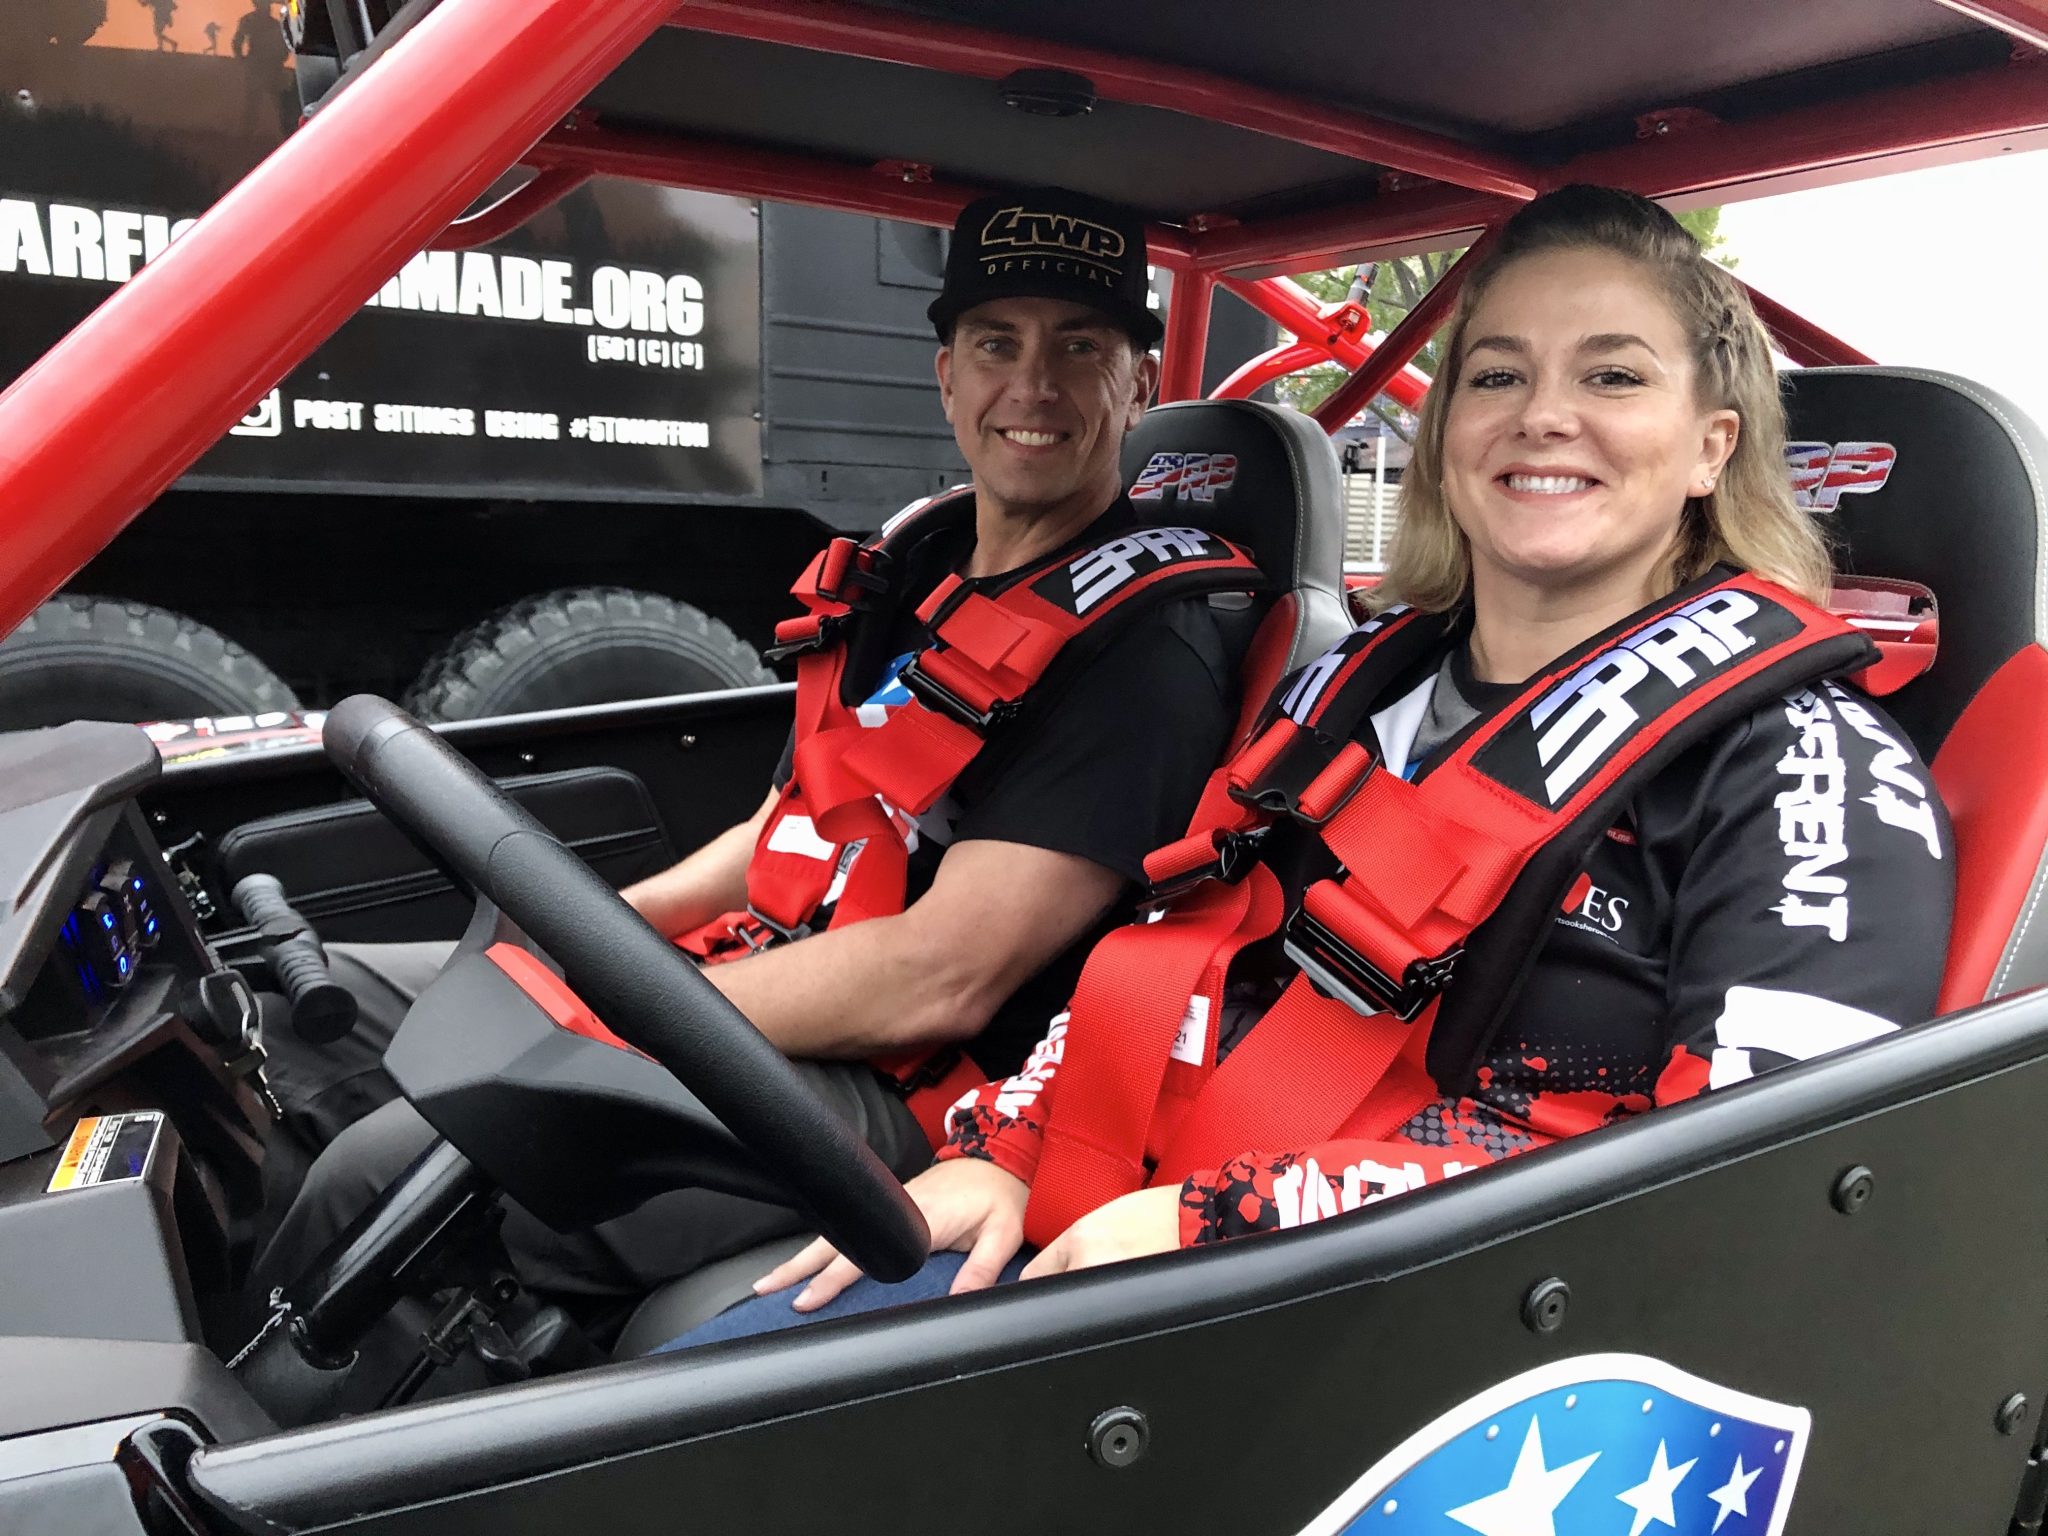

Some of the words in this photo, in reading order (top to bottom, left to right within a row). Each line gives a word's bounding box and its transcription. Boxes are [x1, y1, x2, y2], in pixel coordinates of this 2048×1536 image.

[981, 206, 1125, 258] 4WP
[365, 249, 705, 337] MADE.ORG
[987, 259, 1113, 288] OFFICIAL
[293, 399, 365, 431] POST
[484, 409, 560, 441] USING
